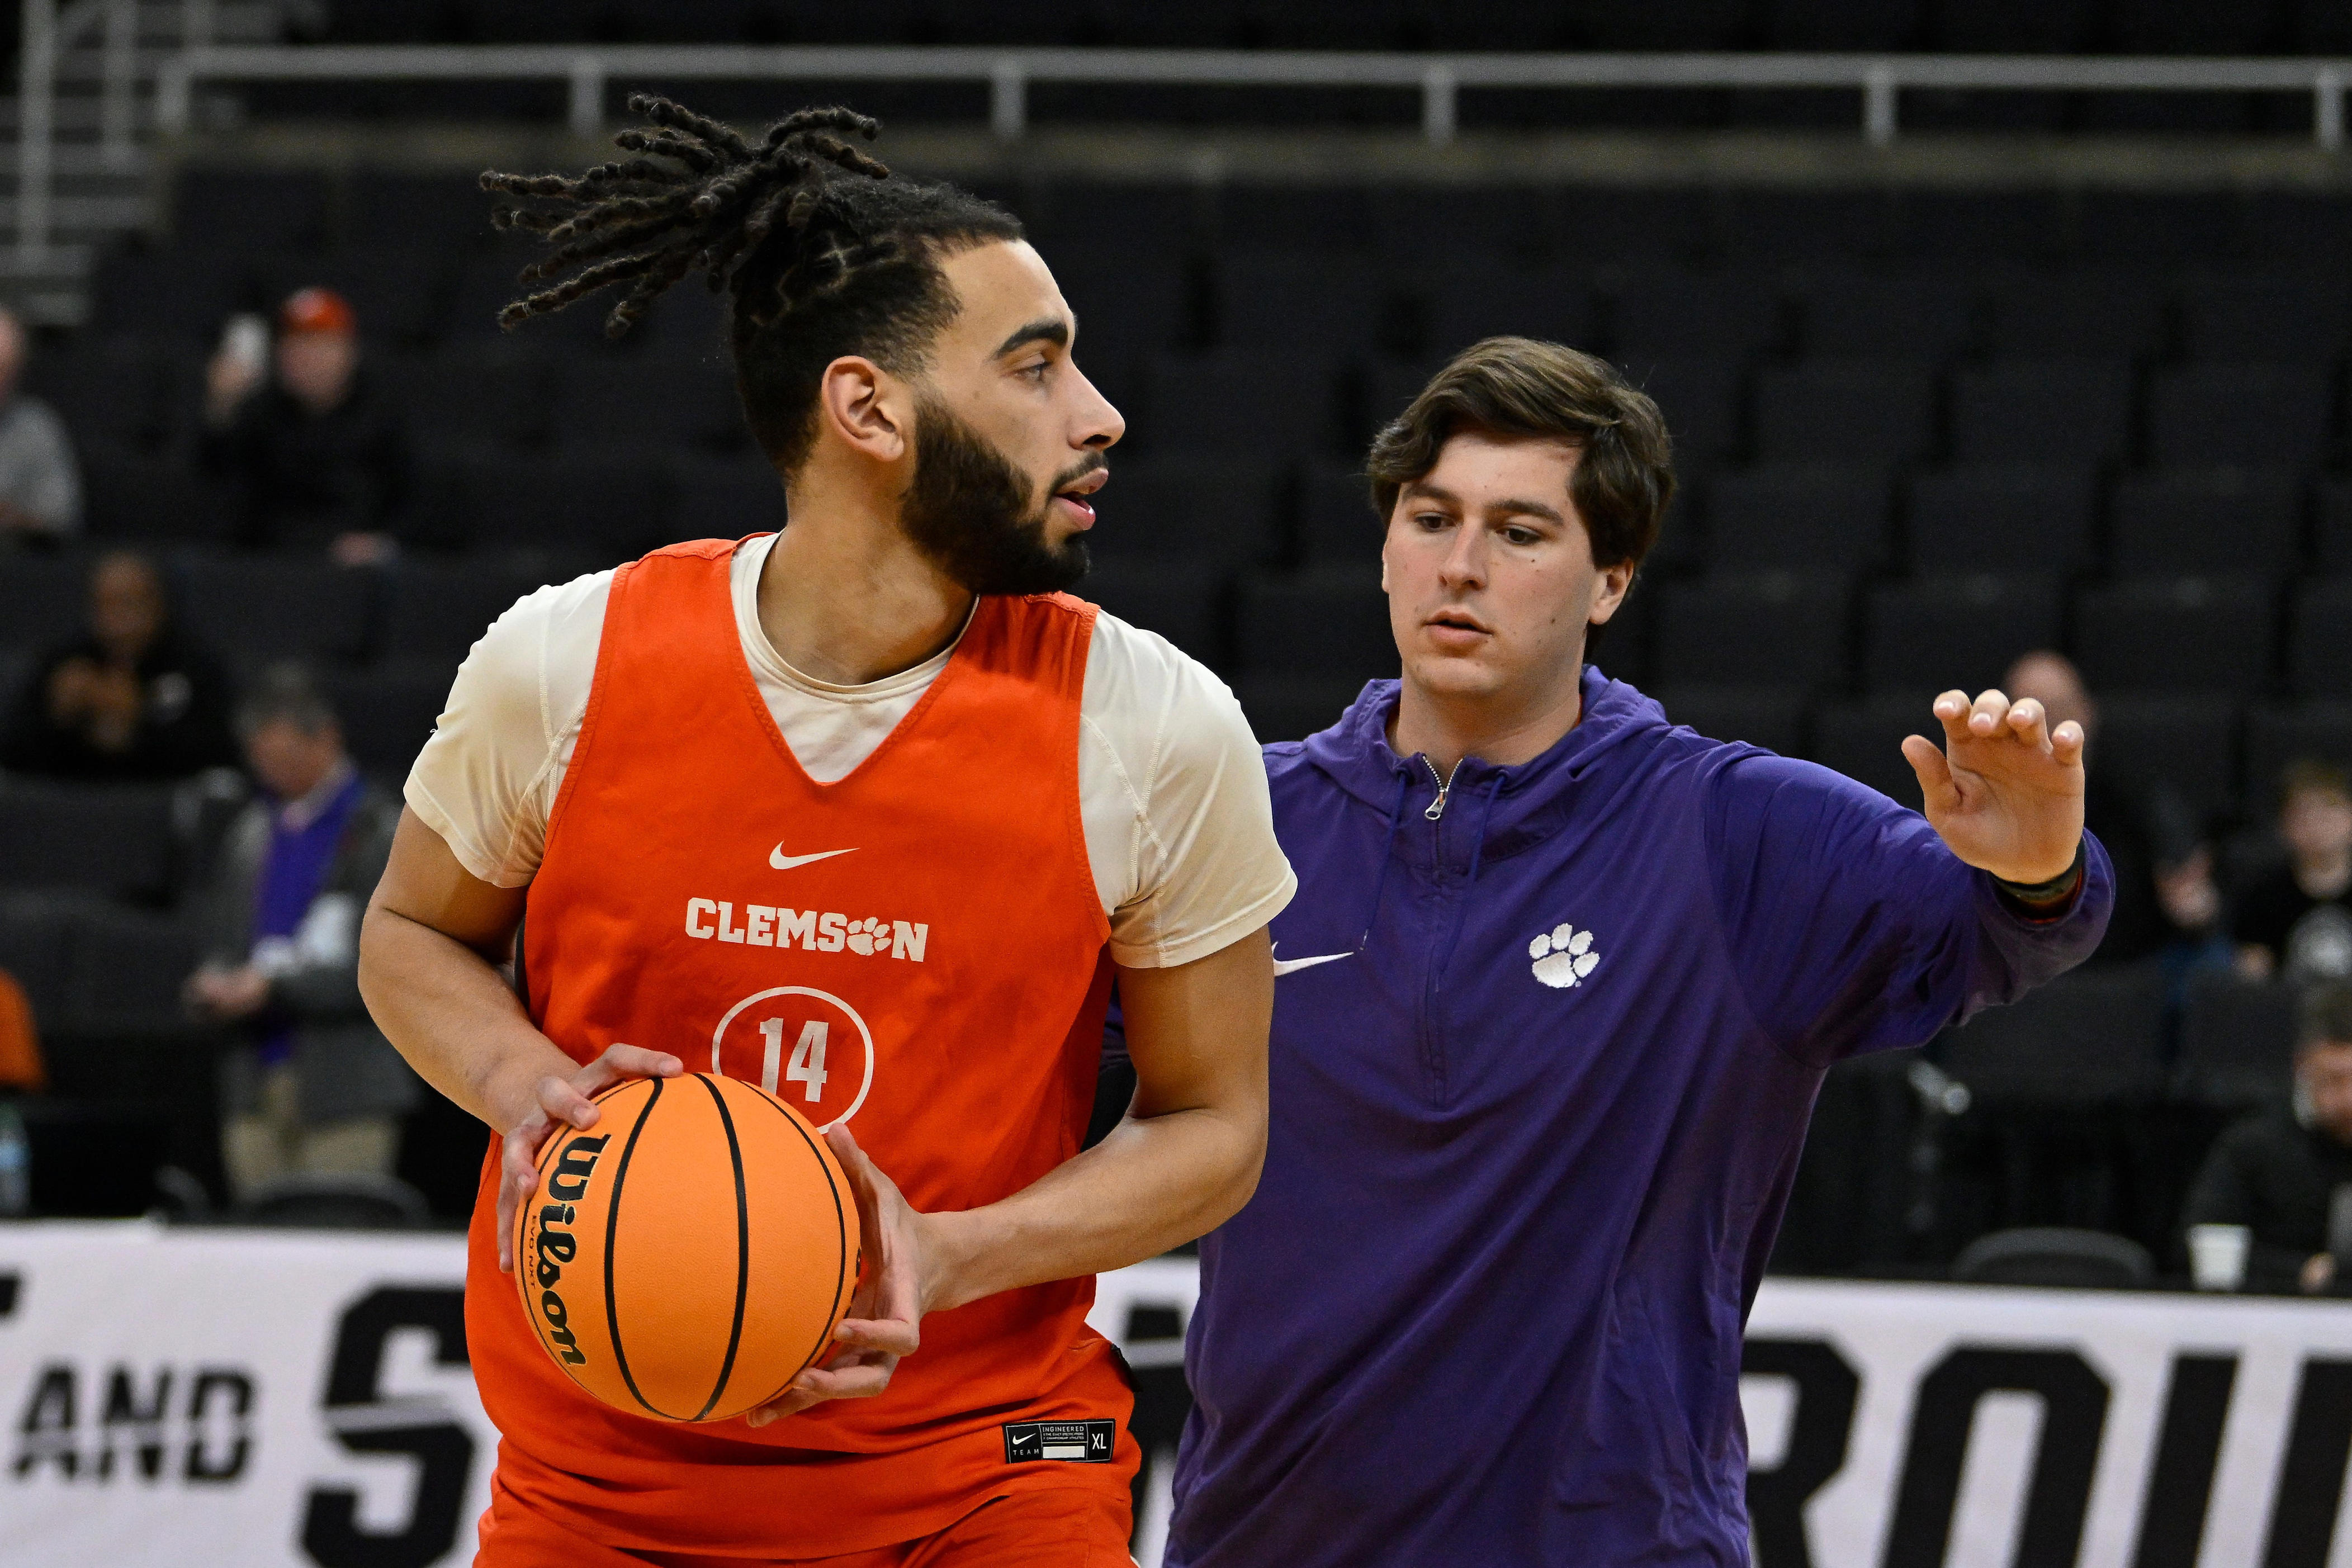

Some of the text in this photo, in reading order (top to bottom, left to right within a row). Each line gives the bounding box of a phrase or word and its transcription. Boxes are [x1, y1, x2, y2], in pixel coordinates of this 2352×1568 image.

[759, 1017, 829, 1102] 14
[528, 1215, 536, 1290] EVO NXT
[536, 1131, 613, 1367] Wilson
[13, 1364, 256, 1482] AND
[1091, 1433, 1107, 1450] XL
